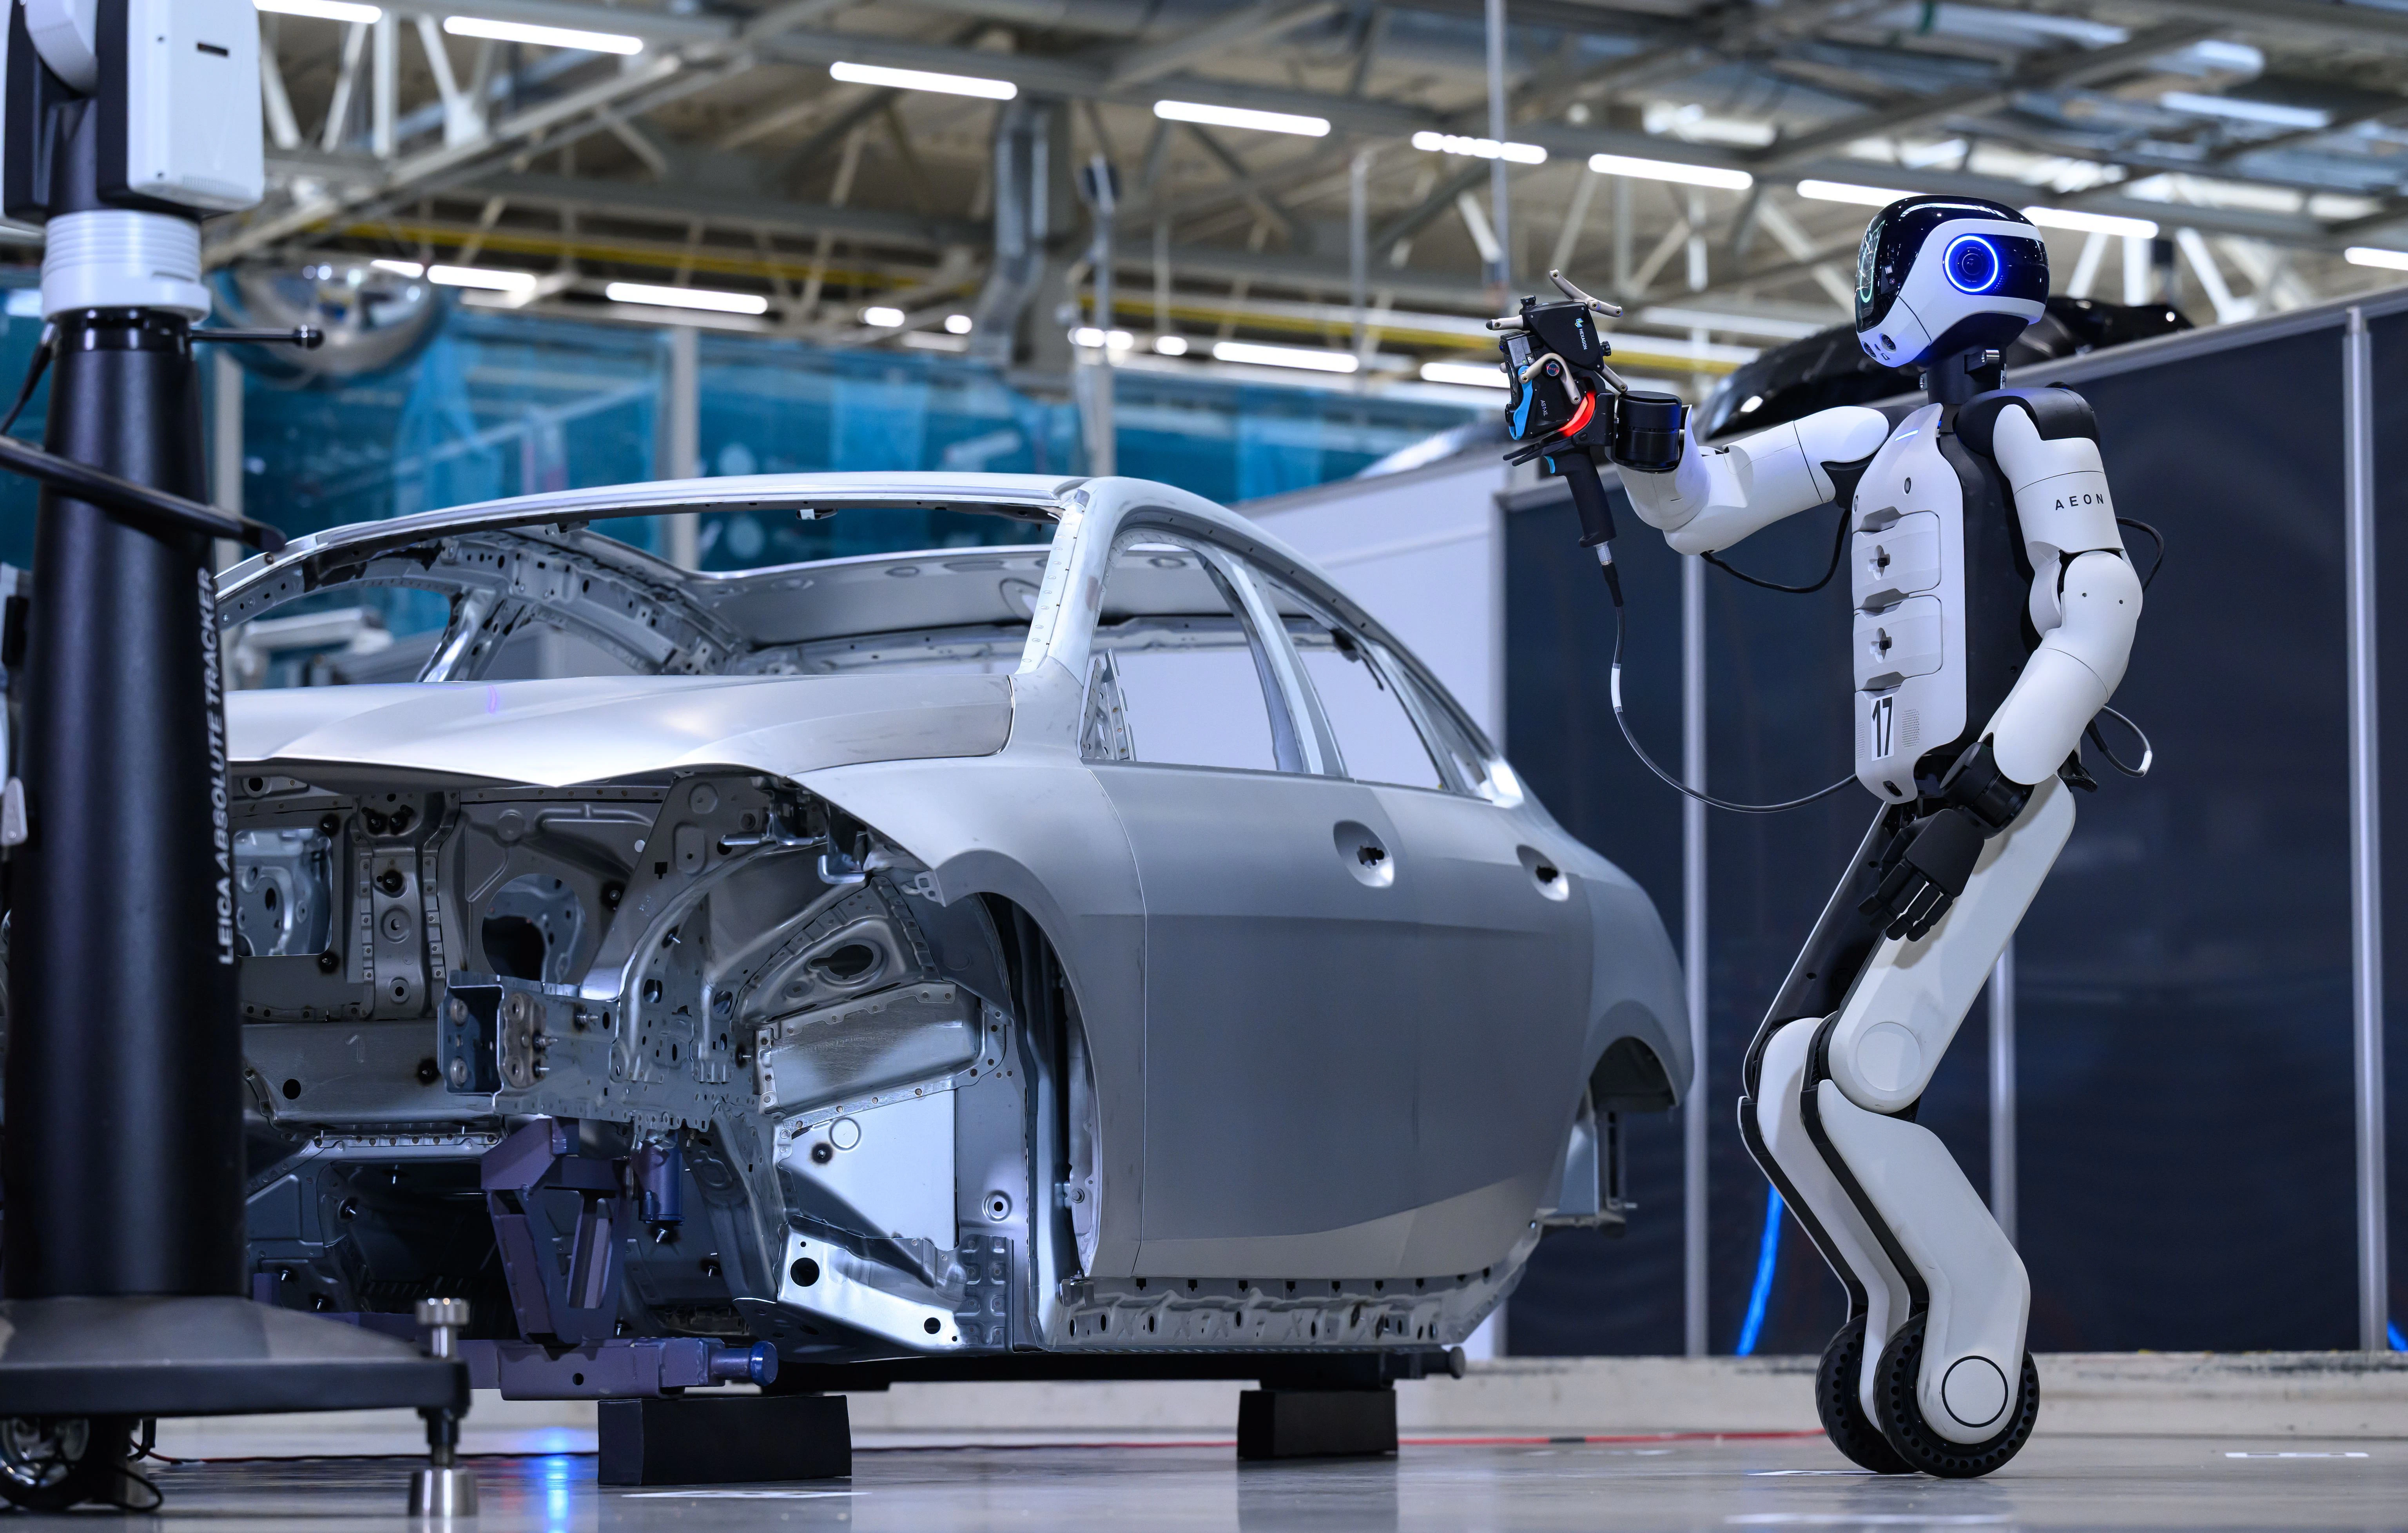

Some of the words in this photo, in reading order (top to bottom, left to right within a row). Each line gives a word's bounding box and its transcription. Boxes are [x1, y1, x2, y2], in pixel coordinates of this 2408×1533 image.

[1579, 328, 1588, 350] HEXAGON
[2055, 493, 2104, 510] AEON
[198, 566, 221, 705] TRACKER
[1872, 696, 1893, 758] 17
[207, 709, 230, 874] ABSOLUTE
[217, 876, 234, 965] LEICA
